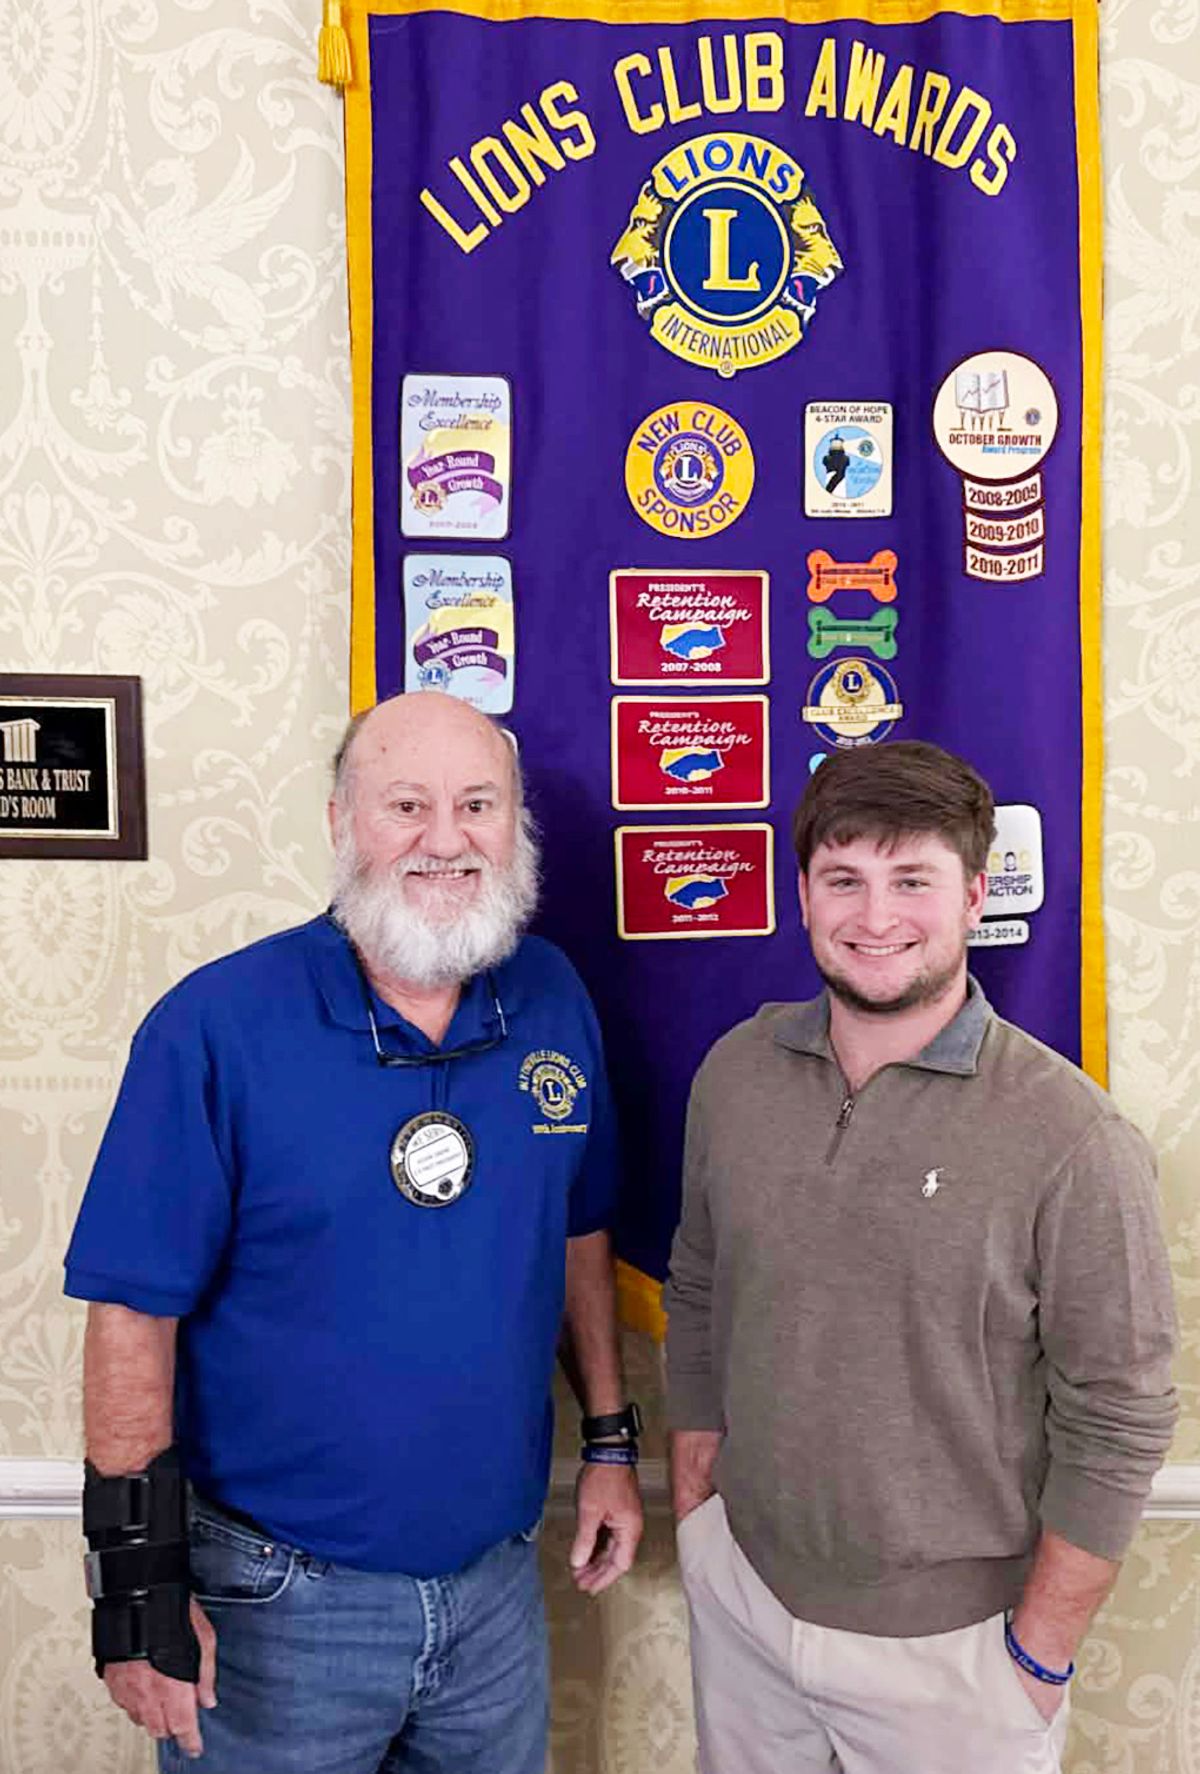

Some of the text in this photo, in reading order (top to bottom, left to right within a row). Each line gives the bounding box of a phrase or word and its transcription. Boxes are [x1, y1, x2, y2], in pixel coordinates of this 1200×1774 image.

[420, 32, 1016, 253] LIONS CLUB AWARDS
[662, 140, 794, 193] LIONS
[703, 209, 761, 291] L
[661, 314, 793, 359] INTERNATIONAL
[407, 388, 502, 413] Membership
[864, 406, 888, 414] HOPE
[419, 412, 493, 431] Excellence
[816, 415, 883, 424] 4-STAR AWARD
[637, 410, 742, 456] NEW CLUB
[949, 433, 1041, 446] OCTOBER GROWTH
[681, 457, 698, 480] L
[448, 476, 483, 491] Growth
[968, 483, 1038, 506] 2008-2009
[637, 488, 739, 532] SPONSOR
[969, 518, 1039, 542] 2009-2010
[970, 553, 1038, 576] 2010-2011
[412, 569, 504, 592] Membership
[425, 590, 496, 609] Excellence
[636, 592, 736, 608] Retention
[649, 607, 752, 628] Campaign
[452, 652, 488, 668] Growth
[847, 674, 860, 689] L
[638, 719, 736, 734] Retention
[649, 733, 752, 752] Campaign
[6, 768, 39, 790] BANK
[41, 768, 51, 790] &
[53, 769, 91, 792] TRUST
[21, 796, 56, 819] ROOM
[642, 847, 740, 862] Retention
[654, 861, 756, 879] Campaign
[987, 886, 1033, 897] ACTION
[965, 927, 1023, 939] 013-2014
[545, 1081, 561, 1101] L
